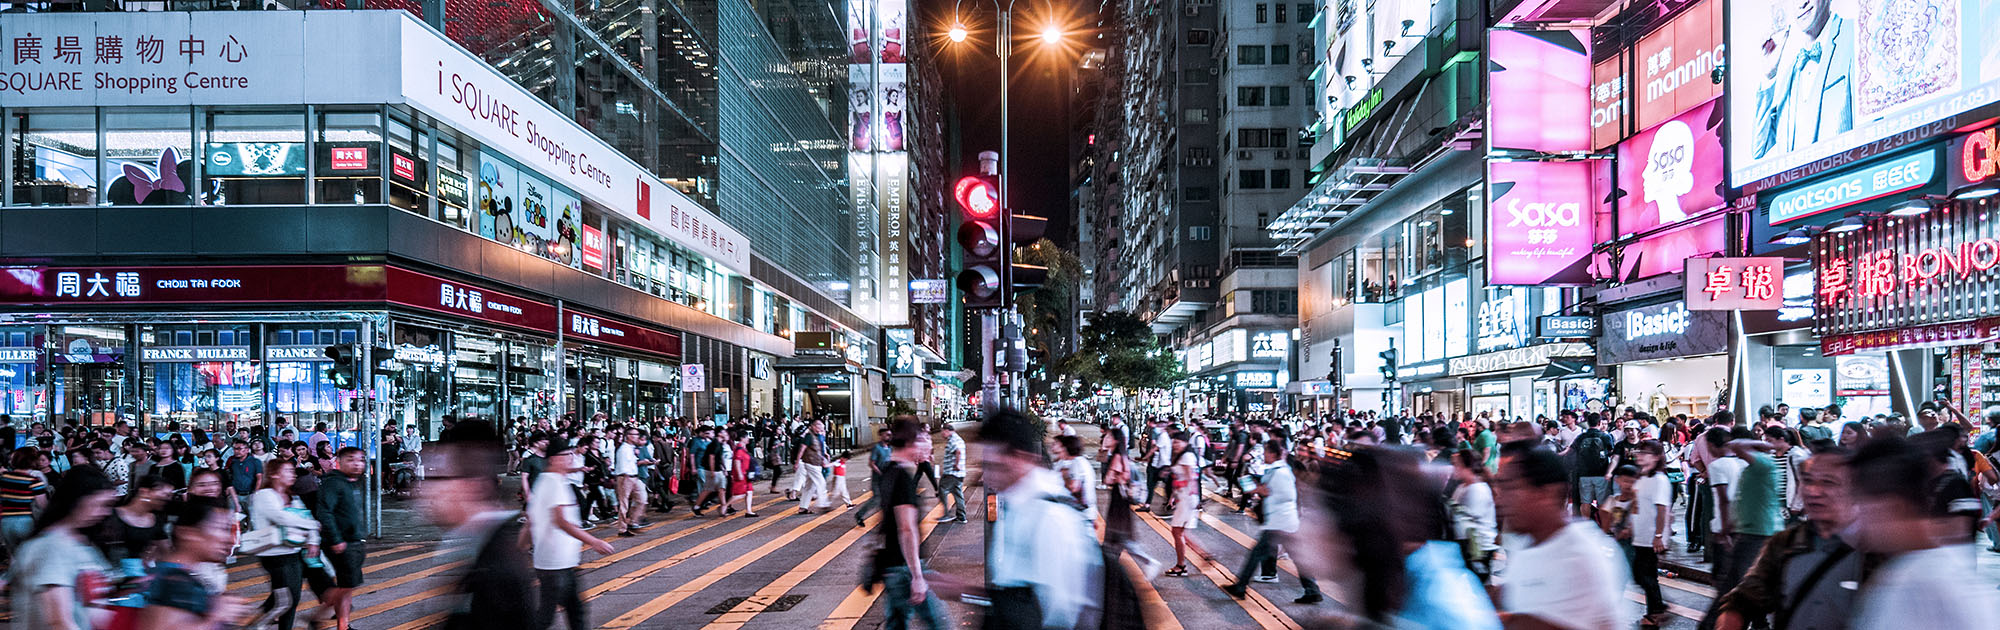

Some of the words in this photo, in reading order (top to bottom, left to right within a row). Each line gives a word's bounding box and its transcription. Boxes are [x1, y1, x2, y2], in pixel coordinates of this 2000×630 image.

[0, 72, 83, 94] SQUARE
[95, 72, 177, 93] Shopping
[184, 72, 248, 88] Centre
[1346, 98, 1371, 132] Holiday
[1371, 88, 1383, 110] Inn
[438, 61, 442, 95] i
[452, 73, 519, 138] SQUARE
[527, 120, 576, 175] Shopping
[579, 153, 611, 189] Centre
[1757, 177, 1776, 191] JM
[1780, 151, 1854, 183] NETWORK
[1861, 115, 1957, 156] 27230020
[1778, 178, 1862, 216] watsons
[1872, 160, 1921, 192] 屈臣氏
[891, 179, 900, 237] EMPEROR
[1737, 194, 1755, 209] JM
[585, 231, 601, 250] 周大
[1534, 248, 1546, 258] life
[1904, 238, 2000, 282] BONJO
[56, 272, 141, 297] 周大福
[157, 280, 188, 289] CHOW
[190, 280, 208, 289] TAI
[210, 279, 241, 288] FOOK
[441, 283, 482, 313] 周大福
[572, 314, 599, 337] 周大福
[144, 349, 193, 359] FRANCK
[197, 349, 247, 358] MULLER
[269, 348, 317, 358] FRANCK
[1639, 343, 1658, 353] design
[1659, 342, 1665, 351] &
[1665, 341, 1677, 351] life
[755, 358, 769, 380] M&S
